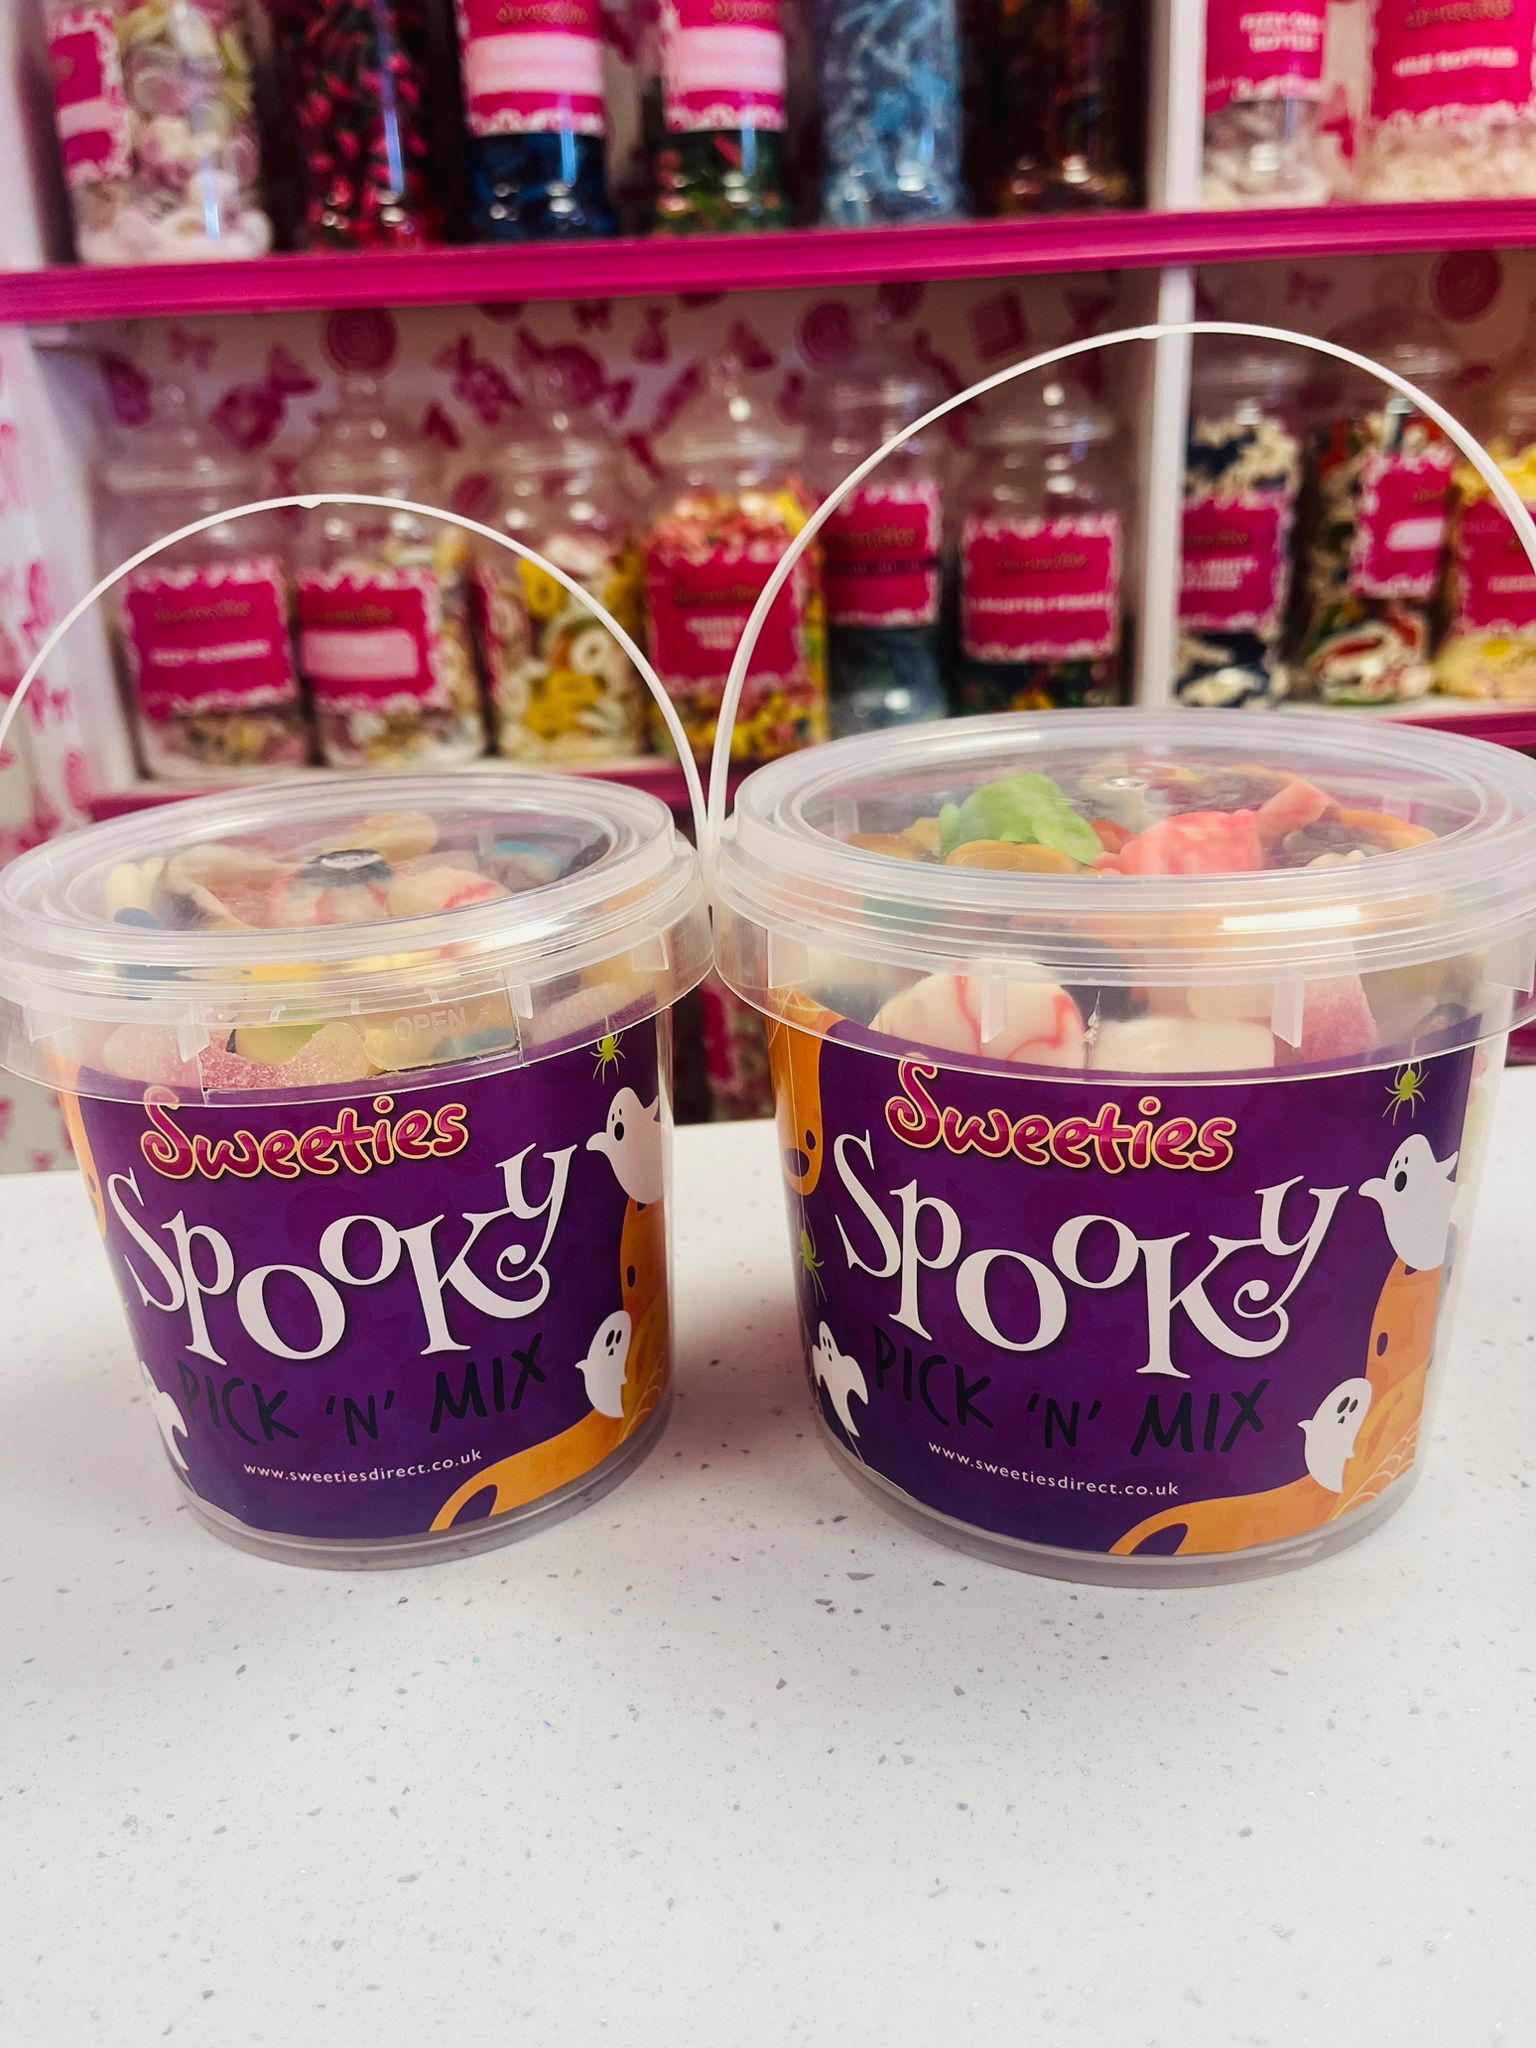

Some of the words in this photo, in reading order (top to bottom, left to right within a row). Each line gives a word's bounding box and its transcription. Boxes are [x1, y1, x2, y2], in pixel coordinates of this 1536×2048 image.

[393, 1007, 467, 1040] OPEN
[141, 1086, 469, 1179] Sweeties
[885, 1058, 1238, 1174] Sweeties
[175, 1355, 300, 1446] PICK
[428, 1332, 547, 1434] MIX
[871, 1324, 994, 1429] PICK
[1129, 1379, 1270, 1457] MIX
[243, 1448, 482, 1483] www.sweetiesdirect.co.uk
[928, 1441, 1180, 1496] www.sweetiesdirect.co.uk
